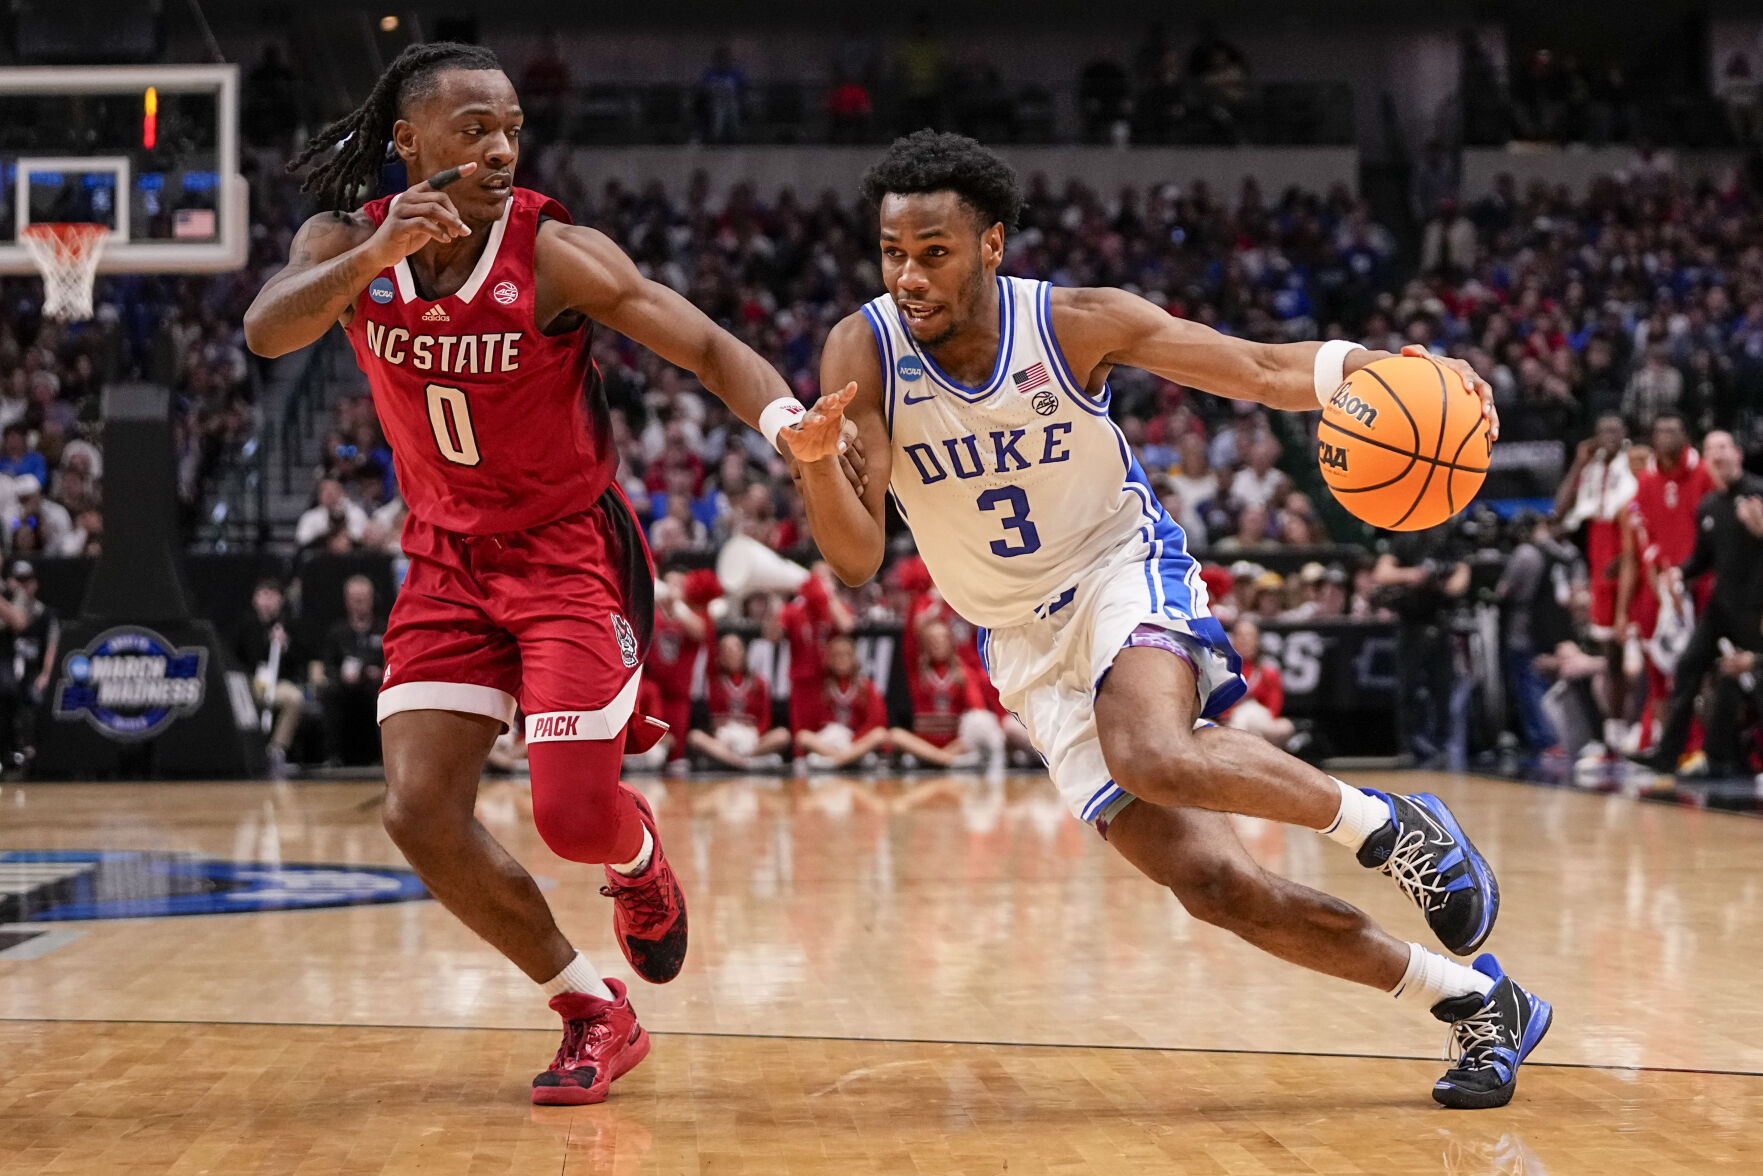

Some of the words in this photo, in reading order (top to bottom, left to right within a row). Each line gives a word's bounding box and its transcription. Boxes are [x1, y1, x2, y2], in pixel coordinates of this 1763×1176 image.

[372, 289, 393, 298] NCAA
[422, 314, 450, 322] adidas
[365, 319, 411, 366] NC
[412, 332, 523, 374] STATE
[900, 367, 922, 376] NCAA
[1330, 381, 1378, 429] lson
[423, 381, 483, 468] 0
[903, 421, 1073, 485] DUKE
[1318, 440, 1349, 472] CAA
[976, 484, 1042, 558] 3
[91, 655, 167, 679] MARCH
[98, 678, 201, 706] MADNESS
[533, 715, 581, 738] PACK
